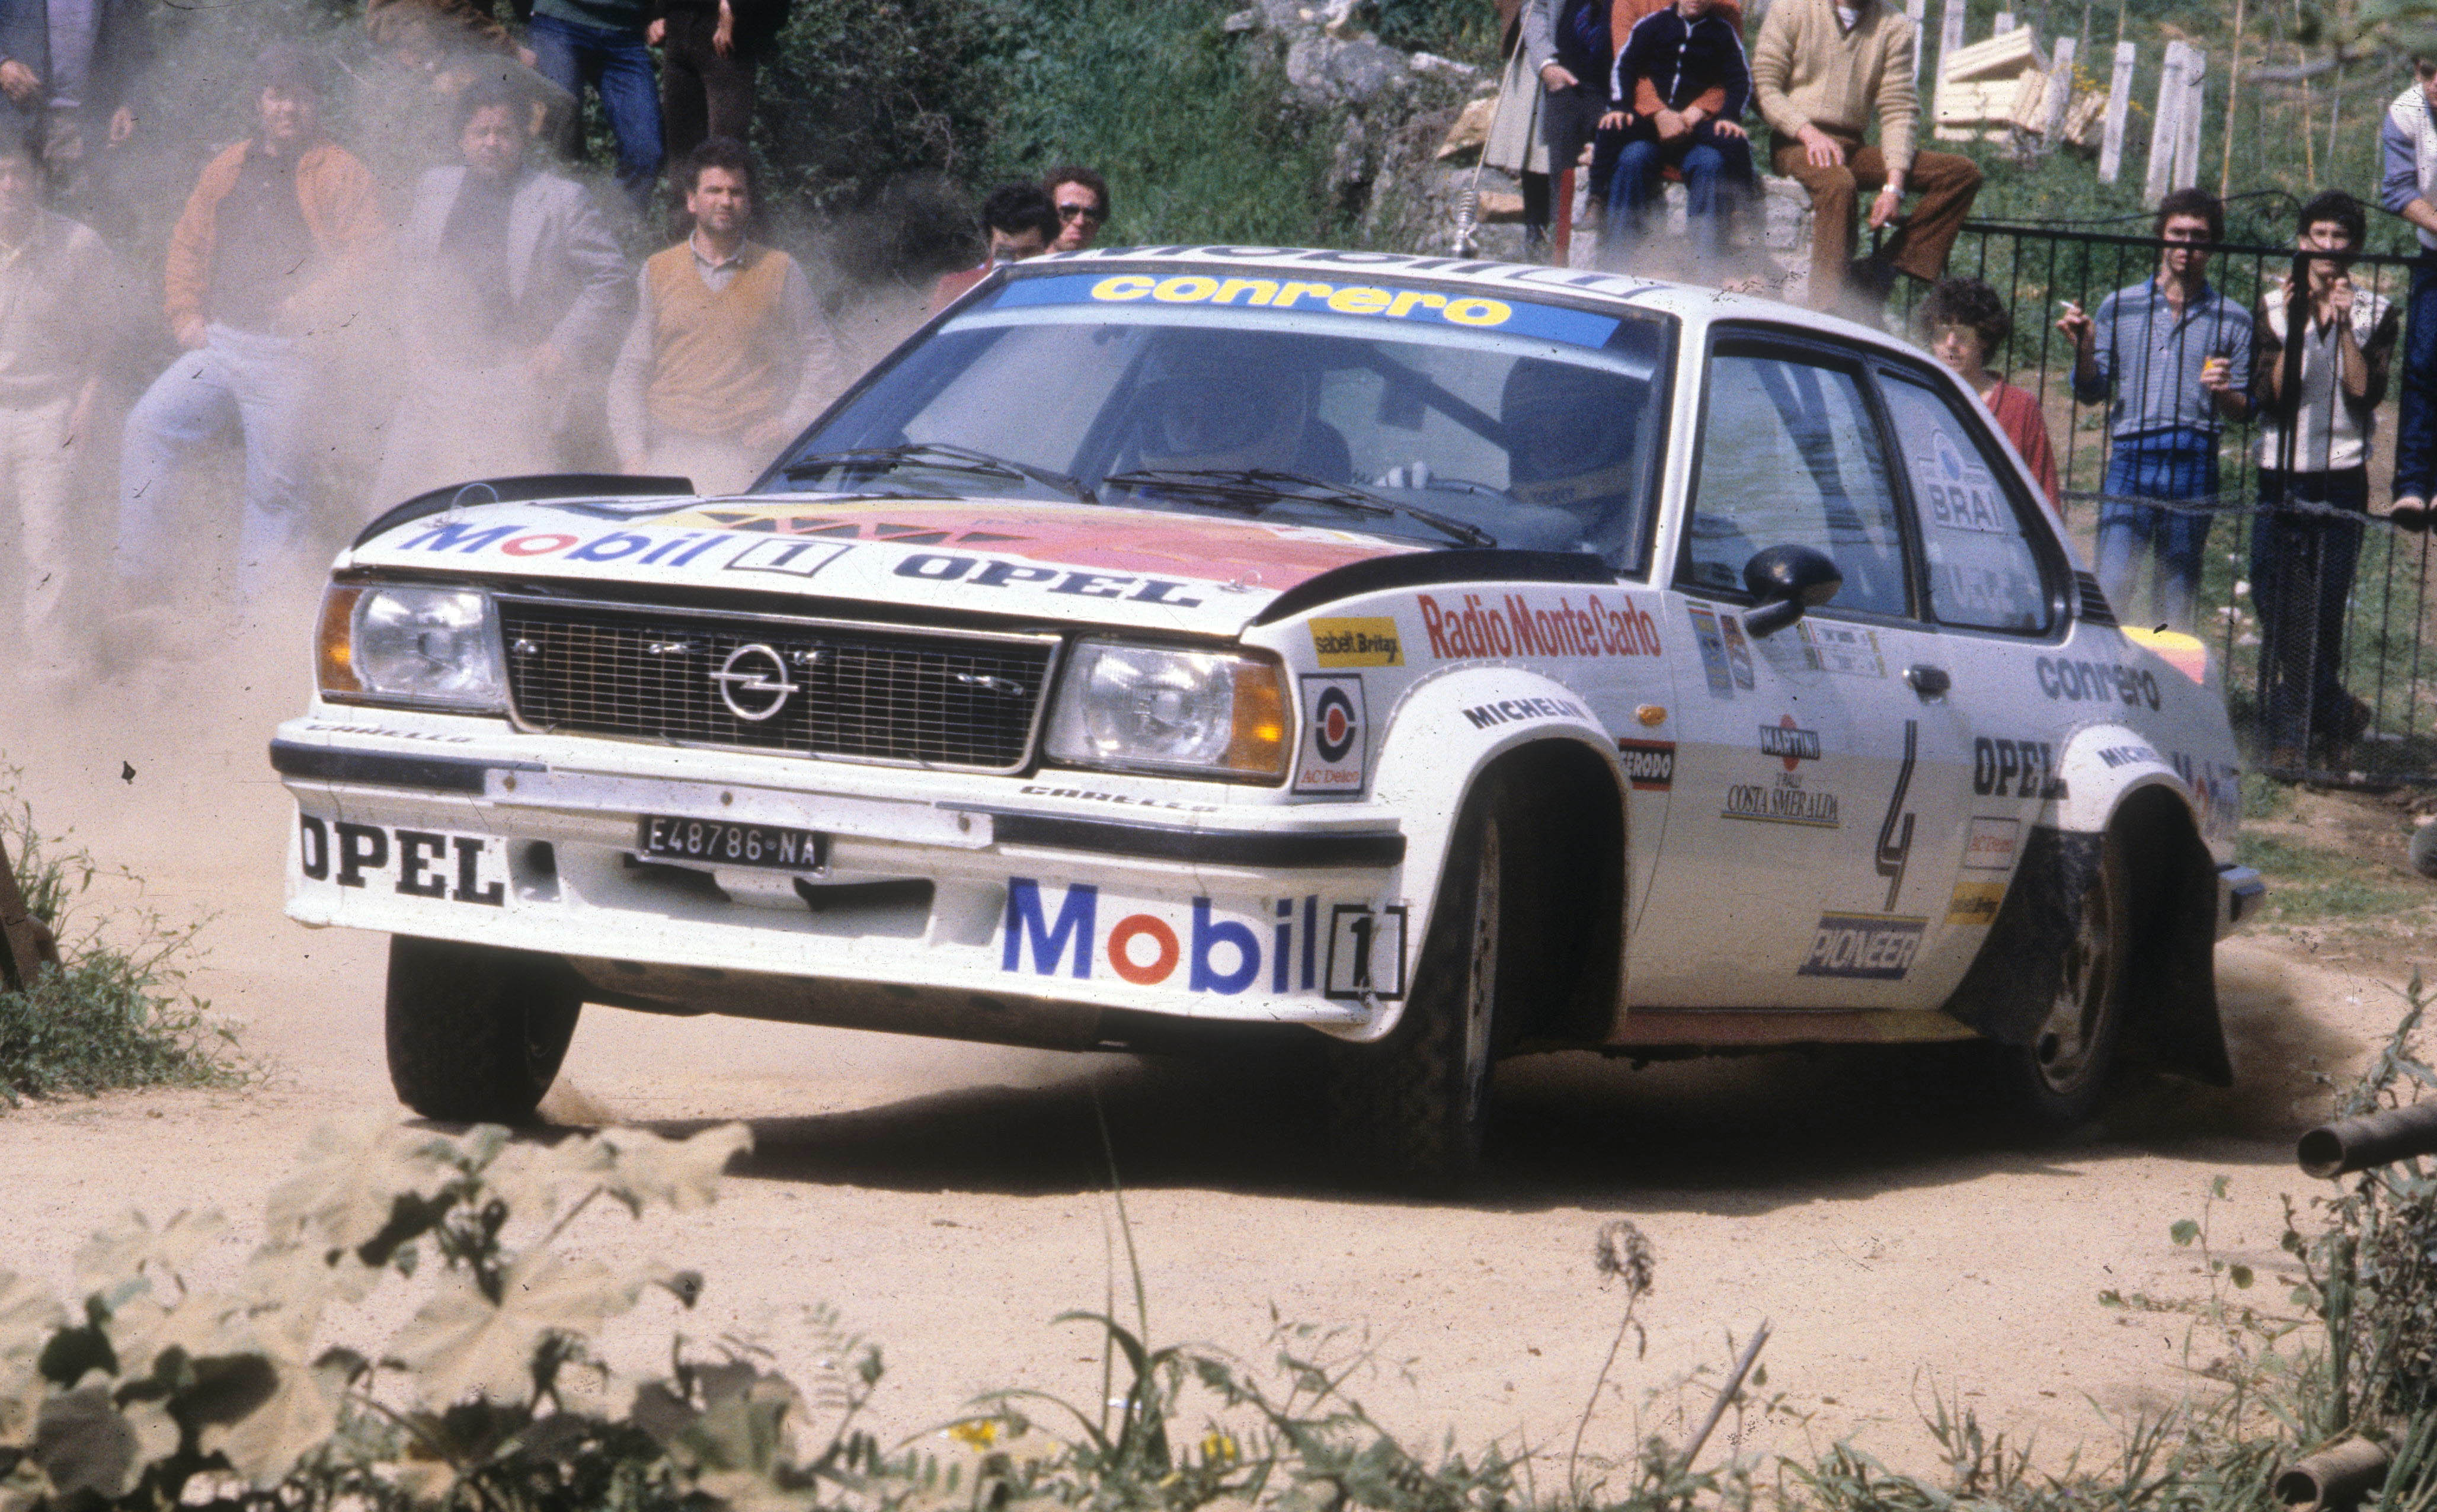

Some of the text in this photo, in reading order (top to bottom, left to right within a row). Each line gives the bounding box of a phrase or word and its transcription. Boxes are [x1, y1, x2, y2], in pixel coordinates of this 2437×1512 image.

[1091, 276, 1511, 326] conrero
[397, 524, 734, 566] Mobil
[893, 553, 1203, 608] OPEL
[1461, 699, 1589, 729] MICHELIN
[1974, 737, 2068, 800] OPEL
[1020, 786, 1218, 812] CARELLO
[1728, 785, 1768, 813] COSTA
[301, 814, 506, 907] OPEL
[1002, 876, 1371, 995] Mobil 1
[1811, 930, 1921, 968] PIONEER
